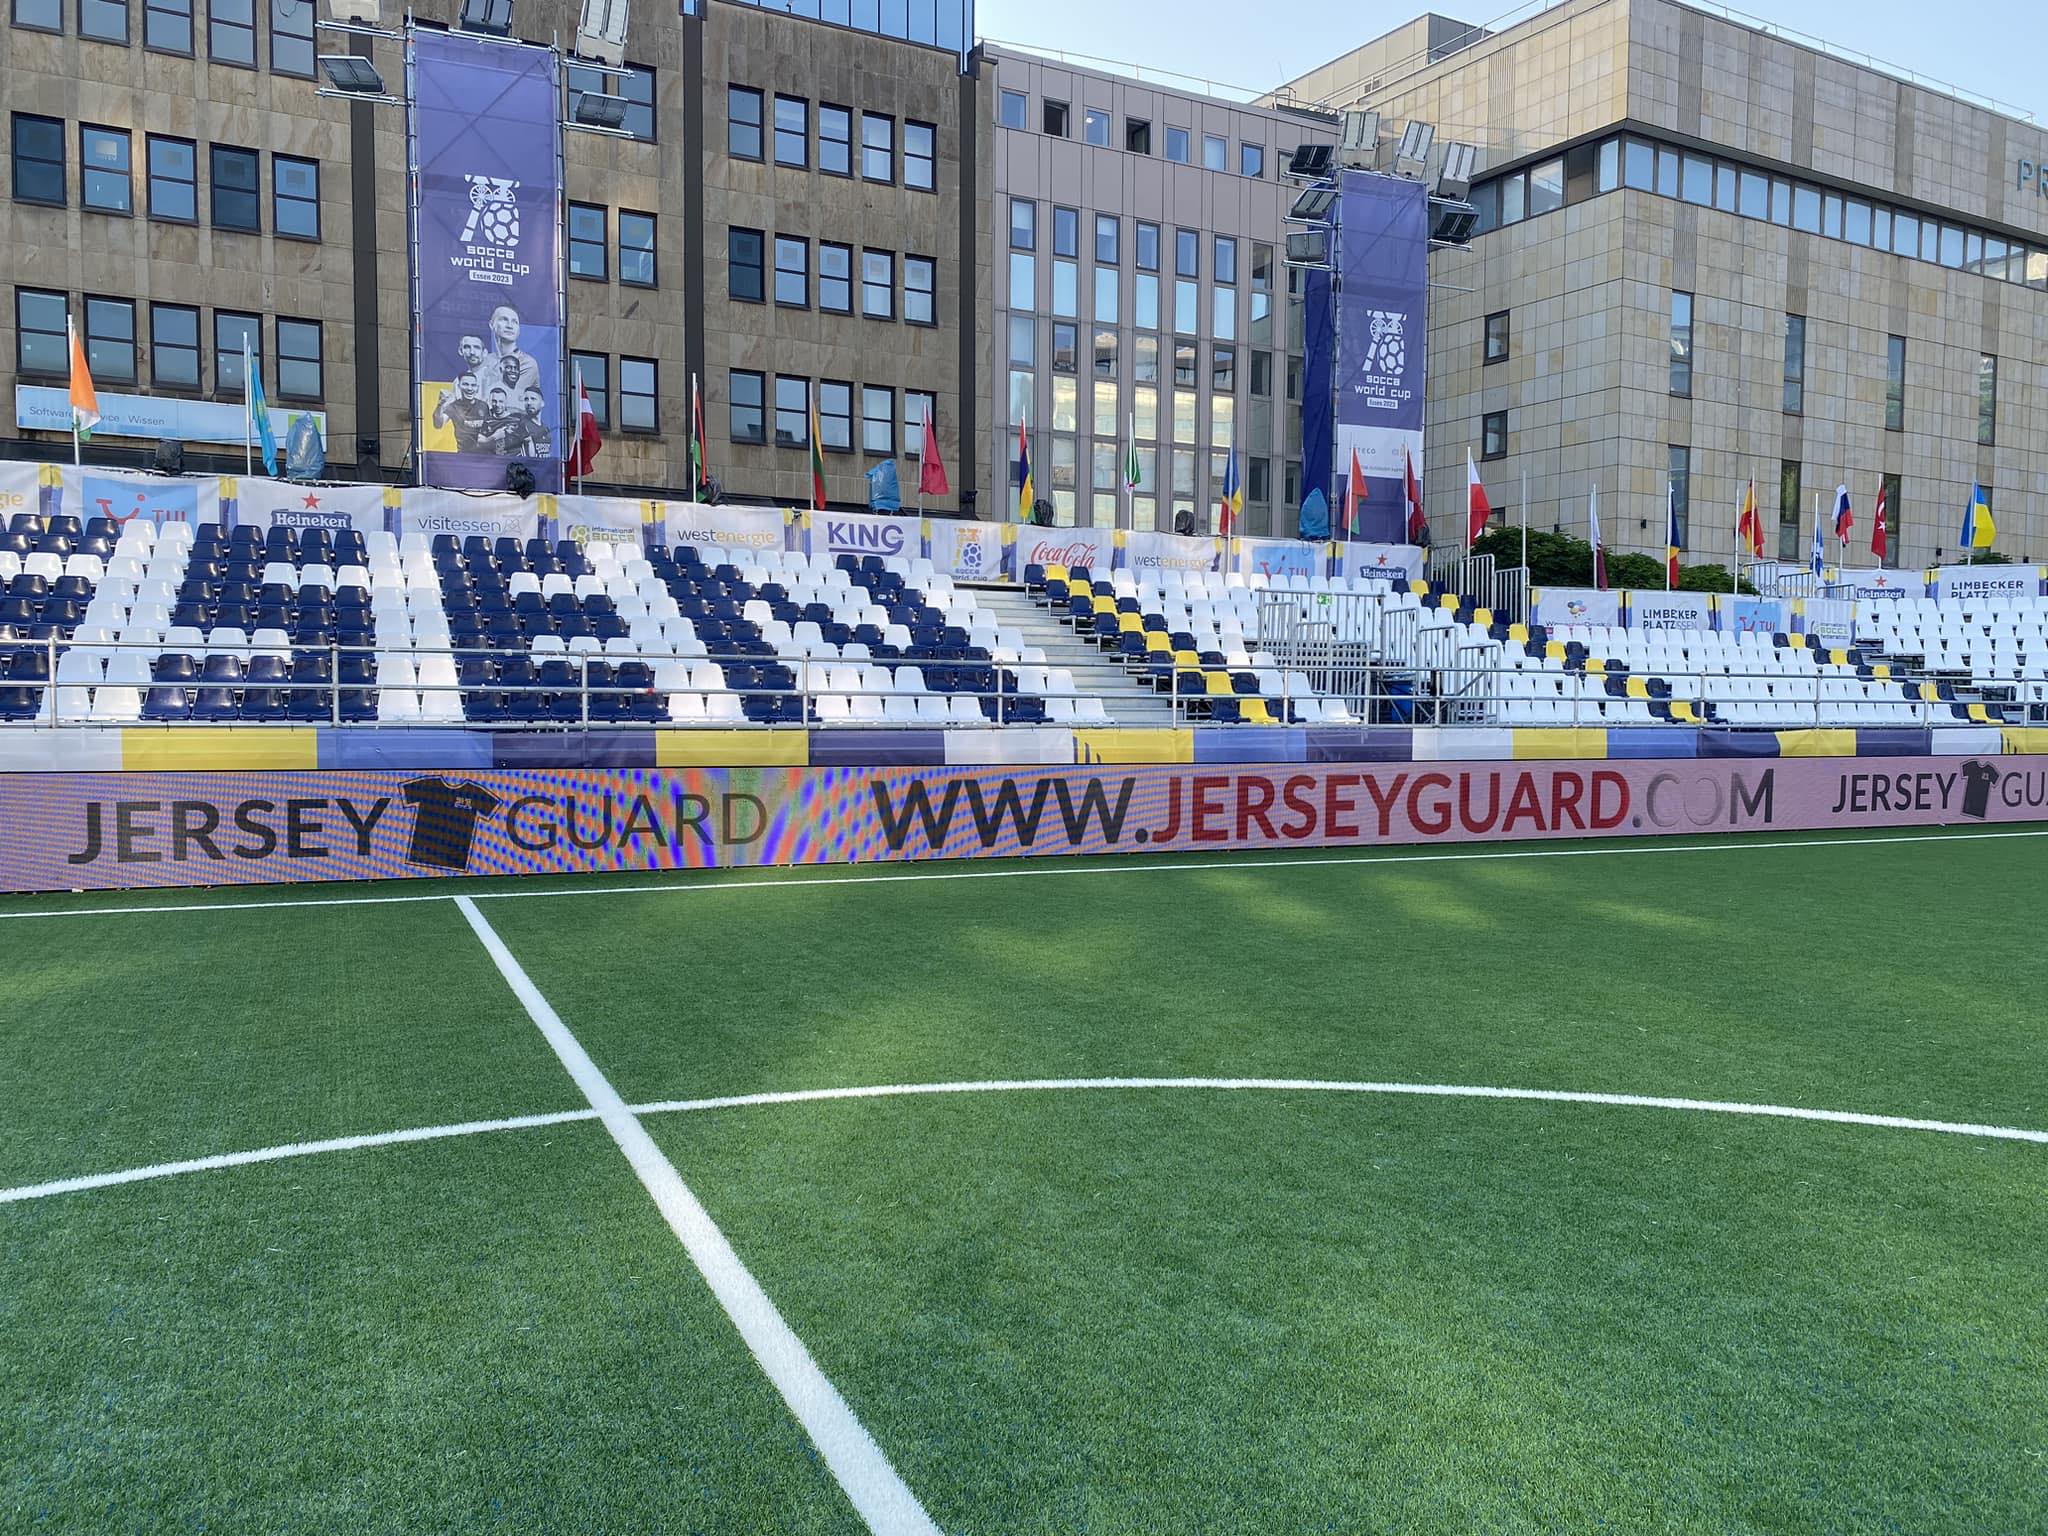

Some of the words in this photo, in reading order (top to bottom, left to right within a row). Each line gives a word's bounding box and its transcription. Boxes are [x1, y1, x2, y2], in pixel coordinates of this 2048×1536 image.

[466, 245, 516, 259] socca
[451, 256, 495, 269] world
[502, 262, 530, 276] cup
[472, 271, 491, 281] Essen
[492, 273, 510, 284] 2023
[1366, 375, 1400, 386] socca
[1354, 384, 1386, 396] world
[1391, 389, 1411, 400] cup
[128, 415, 165, 426] Wissen
[152, 509, 187, 522] TUI
[275, 512, 349, 528] Heineken
[418, 515, 502, 532] visitessen
[678, 528, 776, 546] westenergie
[828, 521, 904, 556] KING
[1363, 567, 1404, 580] Heineken
[1952, 581, 2024, 590] LIMBECKER
[1857, 589, 1903, 599] Heineken
[1760, 621, 1775, 632] TUI
[1832, 772, 1958, 813] JERSEY
[2001, 771, 2048, 807] GU
[870, 768, 1774, 850] WWW.JERSEYGUARD.COM
[68, 797, 392, 864] JERSEY
[506, 790, 767, 851] GUARD
